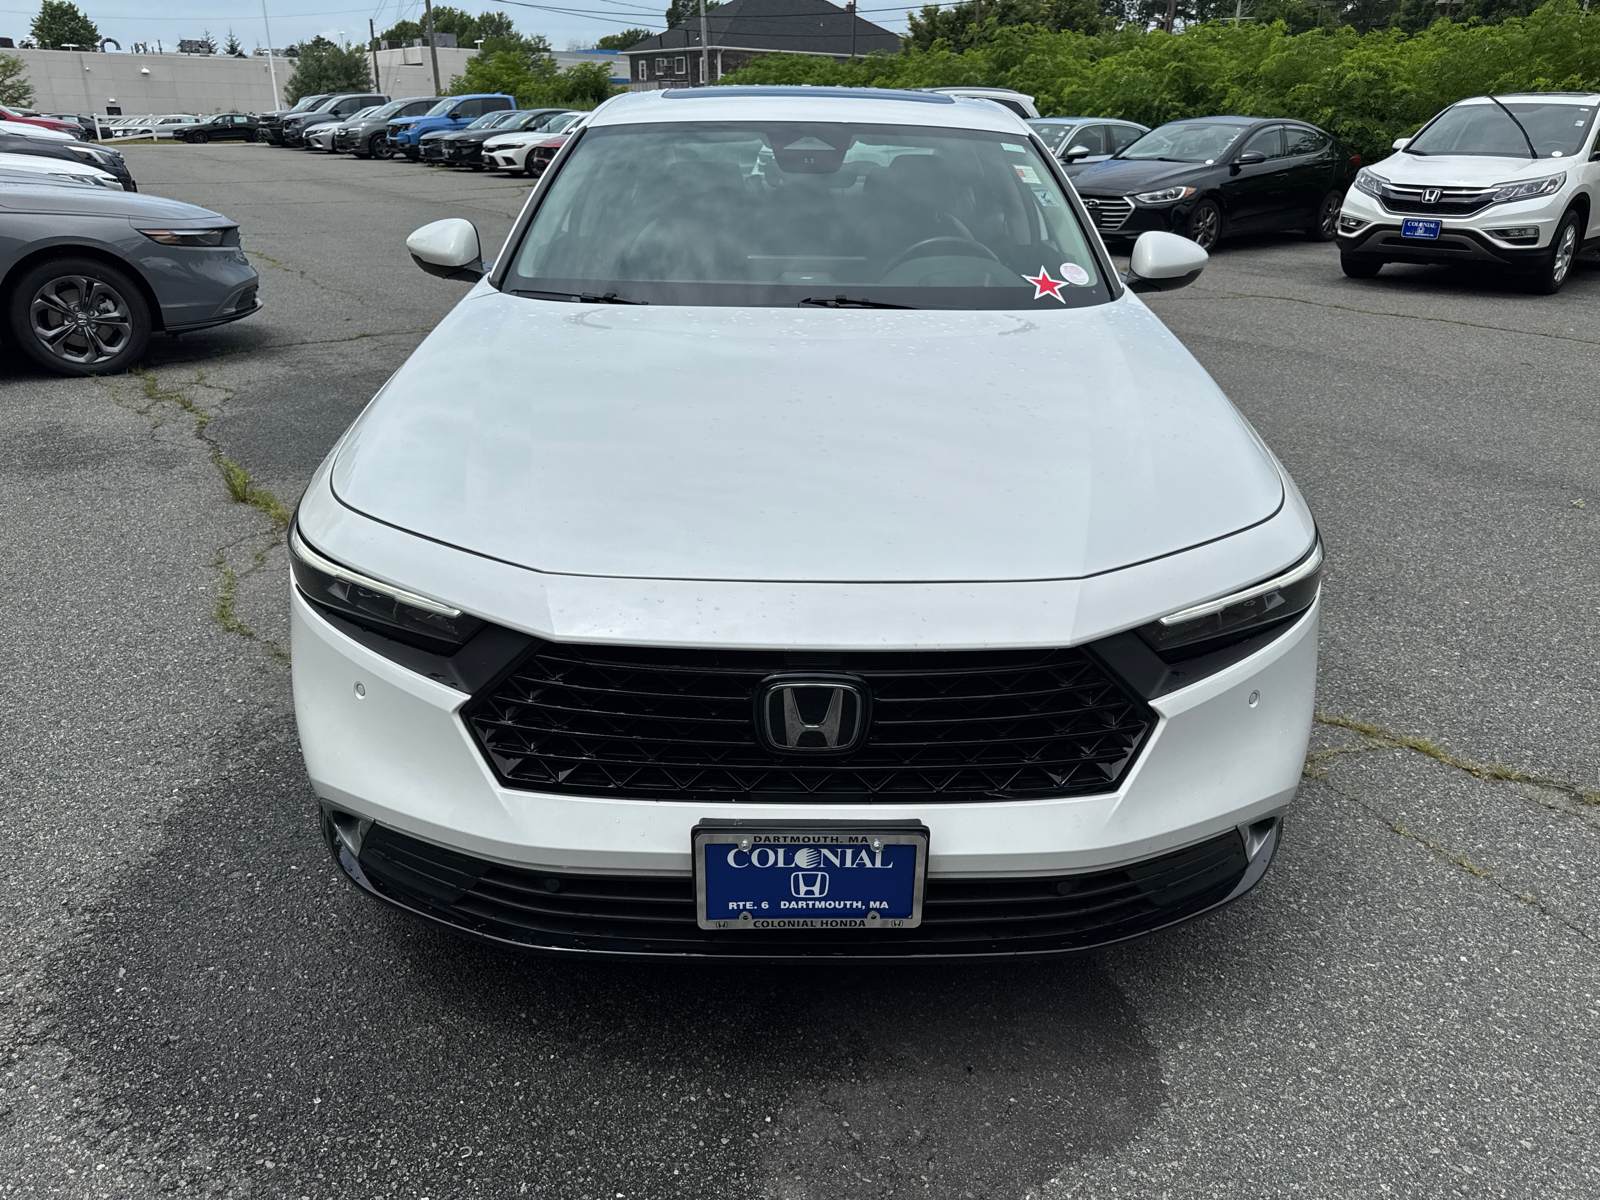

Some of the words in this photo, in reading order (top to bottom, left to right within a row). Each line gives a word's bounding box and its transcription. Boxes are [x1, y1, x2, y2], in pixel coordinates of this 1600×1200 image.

[1407, 221, 1437, 229] COLONIAL
[753, 835, 843, 844] DARTMOUTH,
[848, 836, 869, 844] MA
[726, 847, 894, 869] COLONIAL
[728, 901, 758, 910] RTE.
[761, 901, 770, 910] 6
[780, 900, 866, 911] DARTMOUTH,
[869, 900, 889, 909] MA
[753, 920, 817, 928] COLONIAL
[820, 919, 866, 928] HONDA
